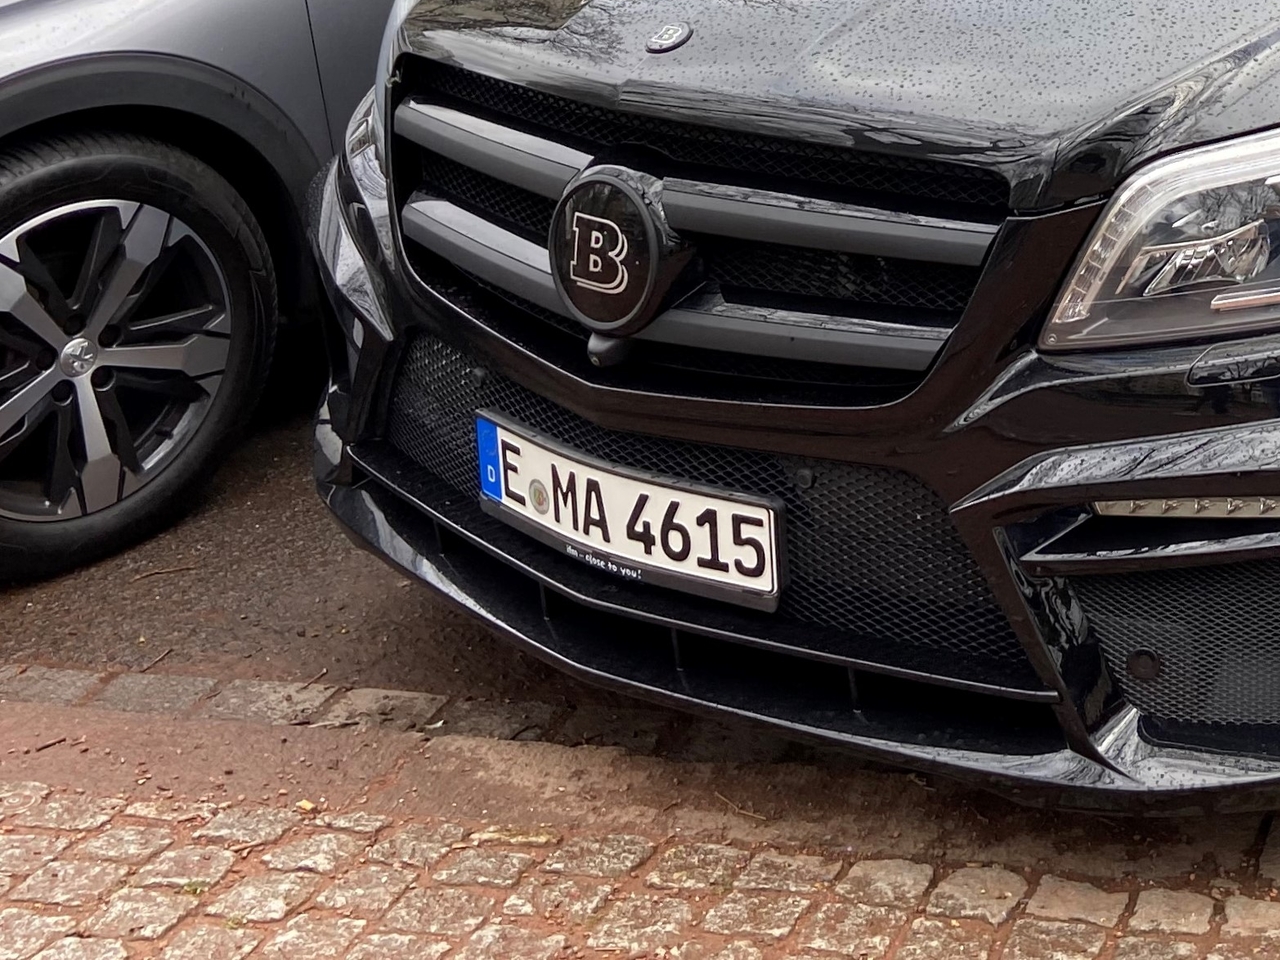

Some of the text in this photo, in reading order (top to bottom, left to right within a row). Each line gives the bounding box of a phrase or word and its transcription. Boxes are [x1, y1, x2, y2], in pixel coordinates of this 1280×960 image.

[570, 211, 629, 294] B
[487, 464, 497, 483] D
[501, 438, 767, 579] E MA 4615
[607, 561, 618, 572] to
